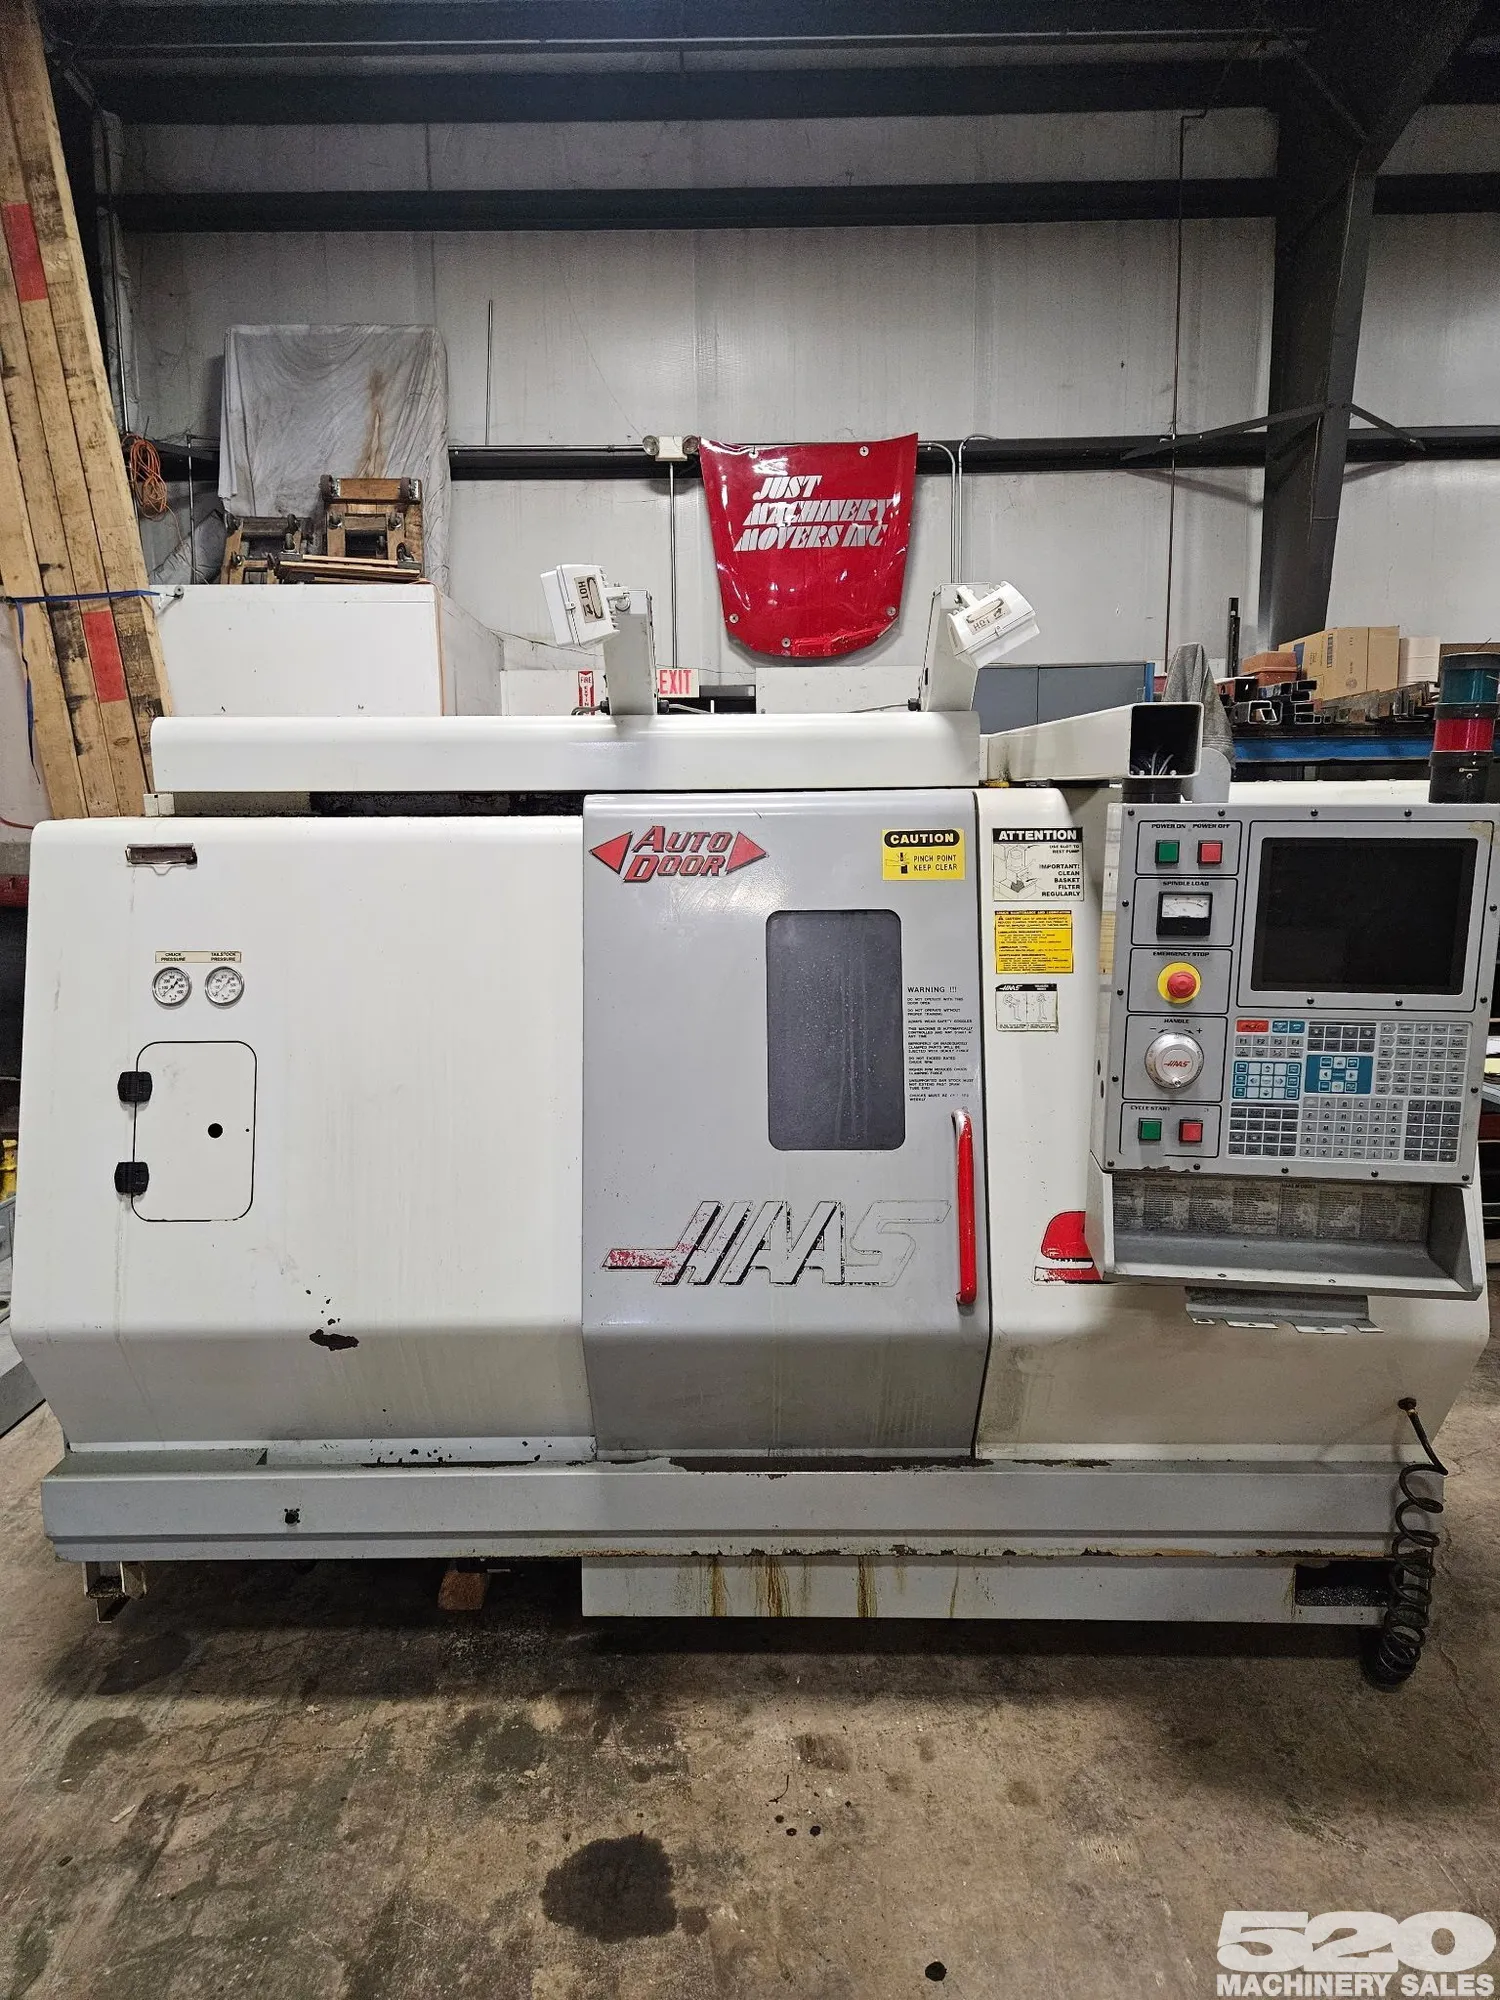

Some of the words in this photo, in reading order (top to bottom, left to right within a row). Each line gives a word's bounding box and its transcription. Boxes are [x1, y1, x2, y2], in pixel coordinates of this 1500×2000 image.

[752, 475, 822, 500] JUST
[743, 499, 895, 526] MACHINERY
[733, 524, 844, 551] MOVERS
[842, 523, 888, 547] INC
[578, 581, 589, 599] HOT
[973, 617, 990, 631] HOT
[659, 669, 691, 695] EXIT
[632, 826, 733, 853] AUTO
[890, 833, 954, 844] CAUTION
[999, 830, 1076, 840] ATTENTION
[623, 855, 726, 883] DOOR
[601, 1200, 952, 1288] HAAS
